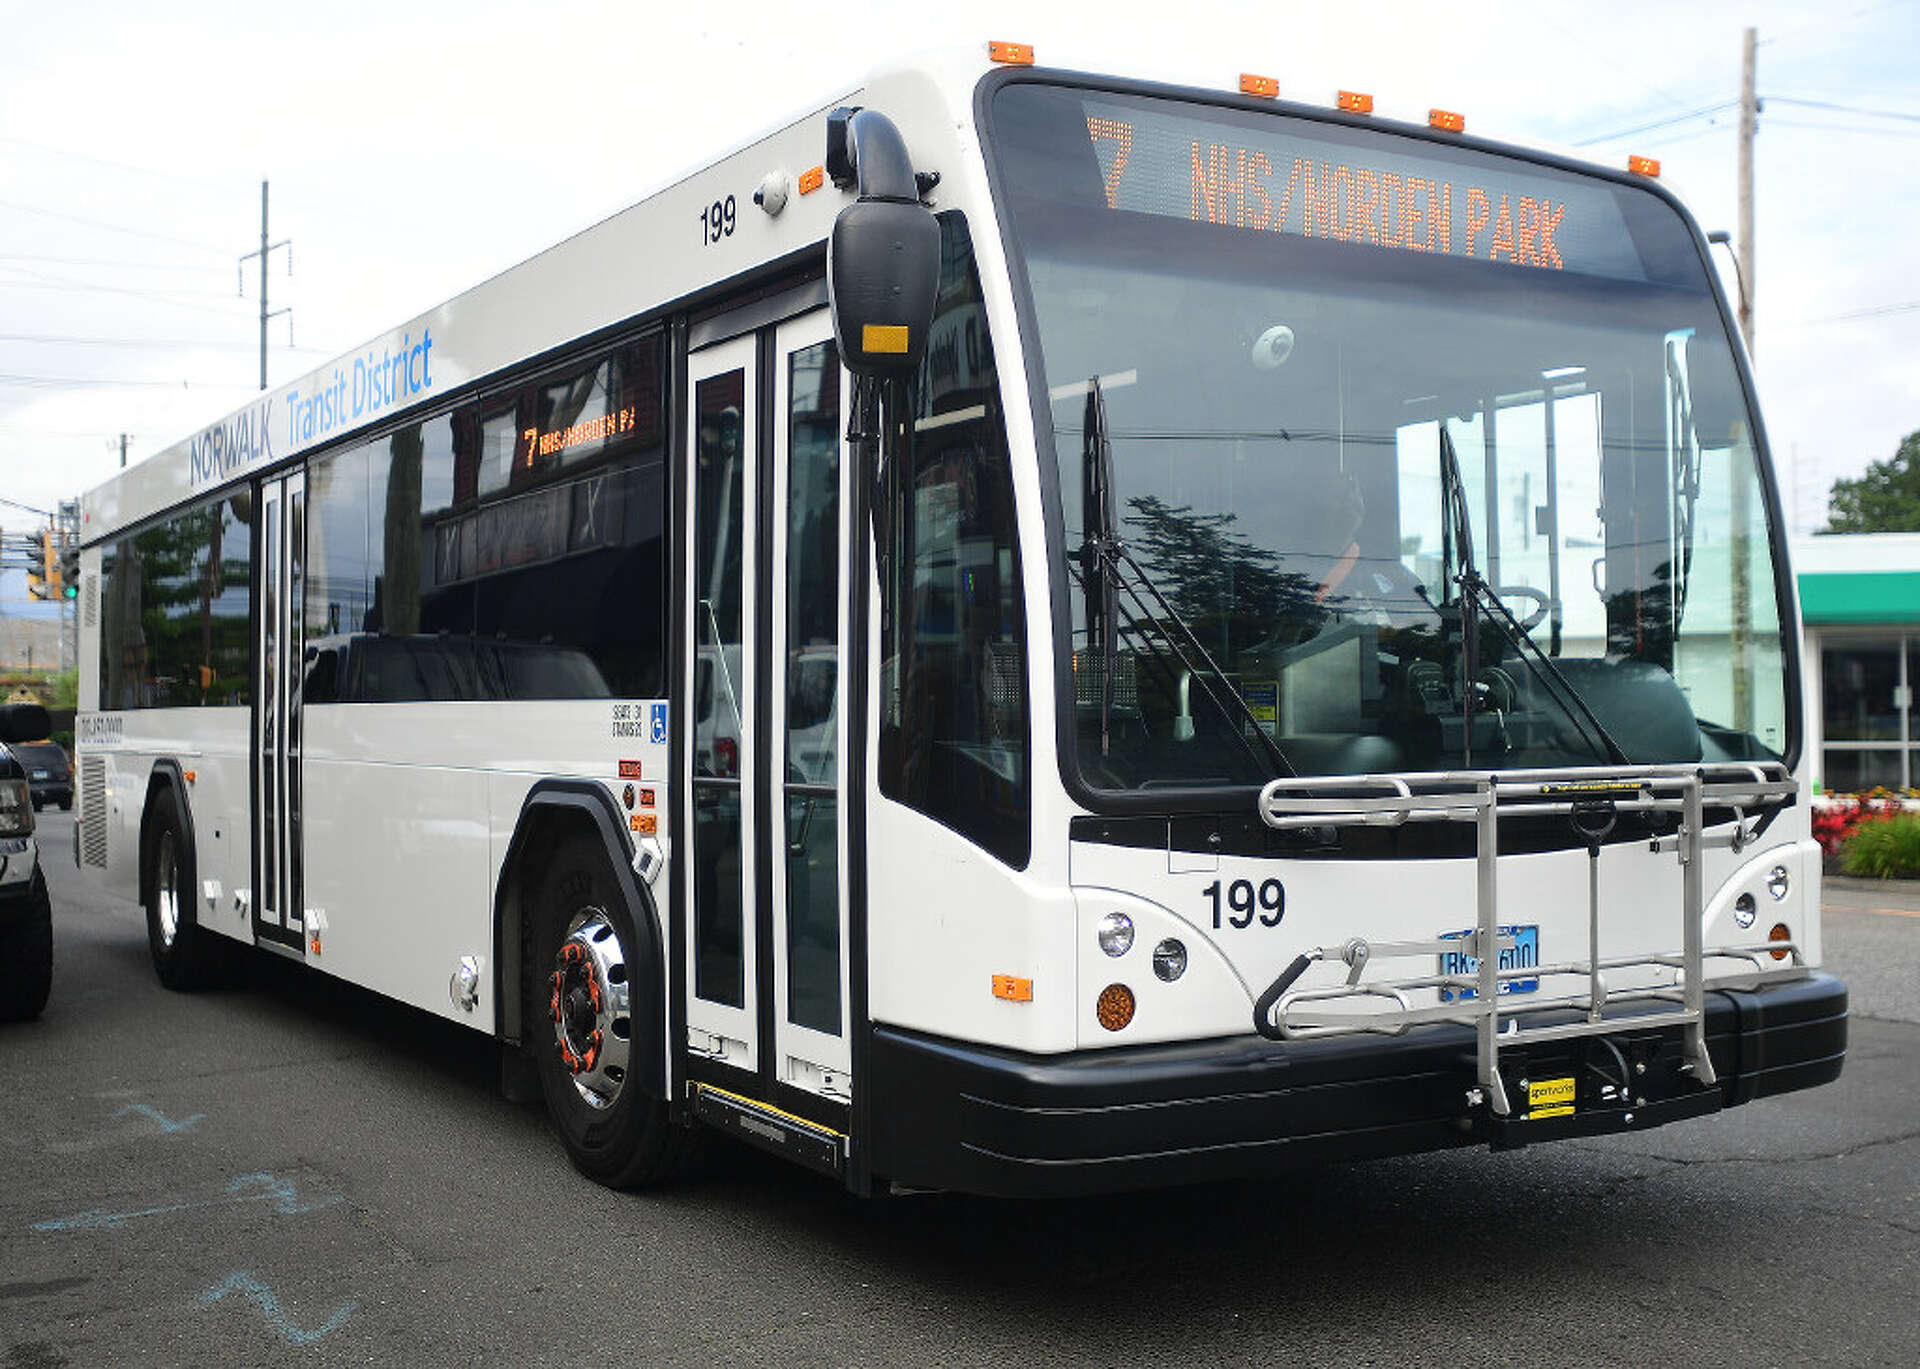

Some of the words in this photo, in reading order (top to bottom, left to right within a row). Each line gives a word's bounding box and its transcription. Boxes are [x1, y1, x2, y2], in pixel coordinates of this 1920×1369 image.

[1086, 116, 1133, 210] 7
[1191, 141, 1451, 255] NHS/NORDEN
[1466, 187, 1566, 271] PARK
[700, 194, 736, 247] 199
[189, 398, 273, 487] NORWALK
[286, 368, 347, 447] Transit
[353, 329, 433, 419] District
[524, 426, 538, 467] 7
[1202, 878, 1286, 929] 199
